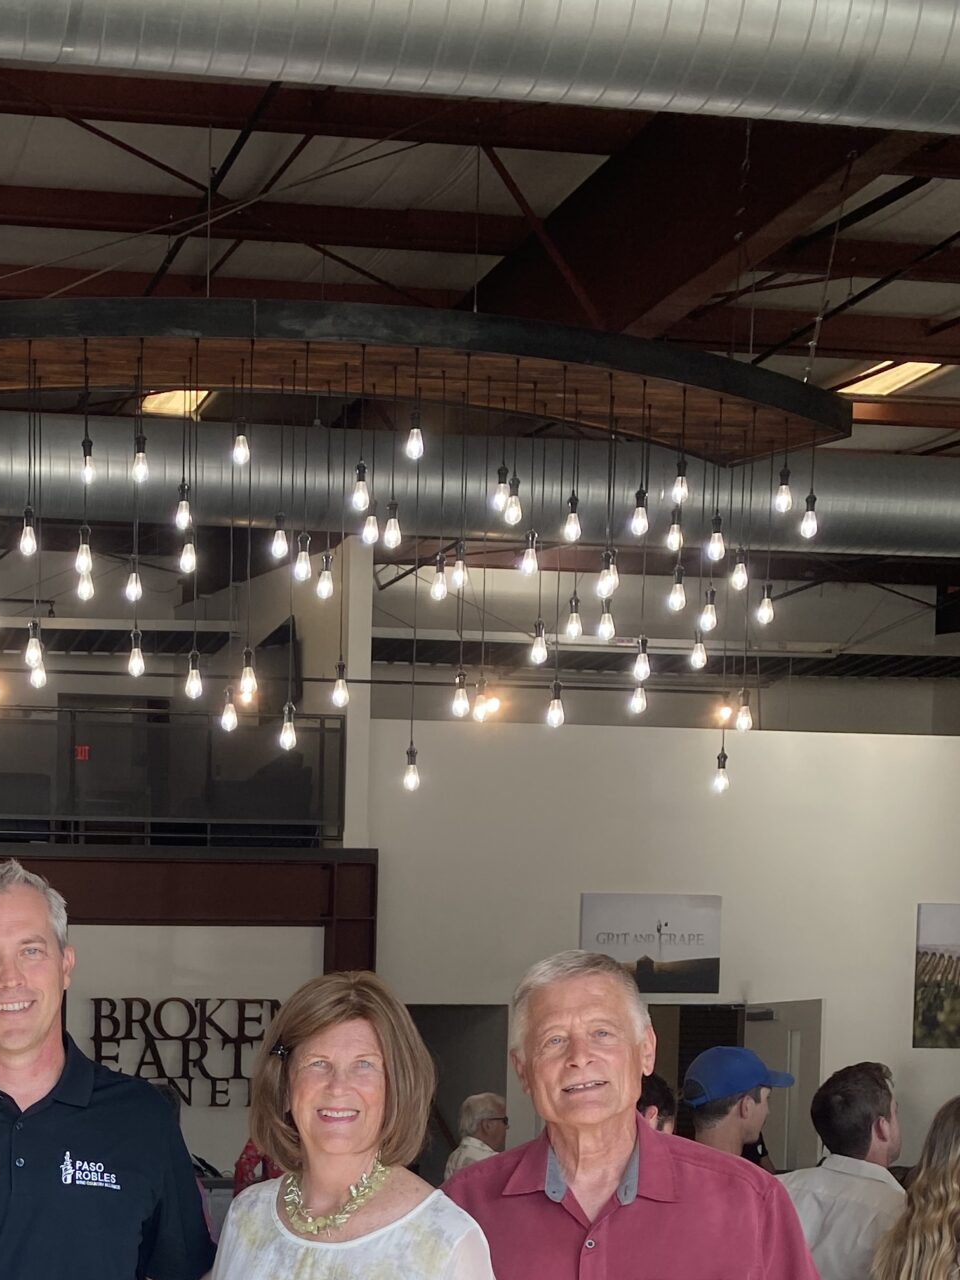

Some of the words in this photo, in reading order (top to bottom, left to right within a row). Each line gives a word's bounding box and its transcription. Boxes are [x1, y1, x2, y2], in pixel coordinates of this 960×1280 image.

[596, 932, 630, 945] GRIT
[633, 934, 656, 944] AND
[659, 932, 705, 946] GRAPE
[93, 1037, 254, 1080] EART
[75, 1160, 105, 1173] PASO
[75, 1170, 117, 1184] ROBLES
